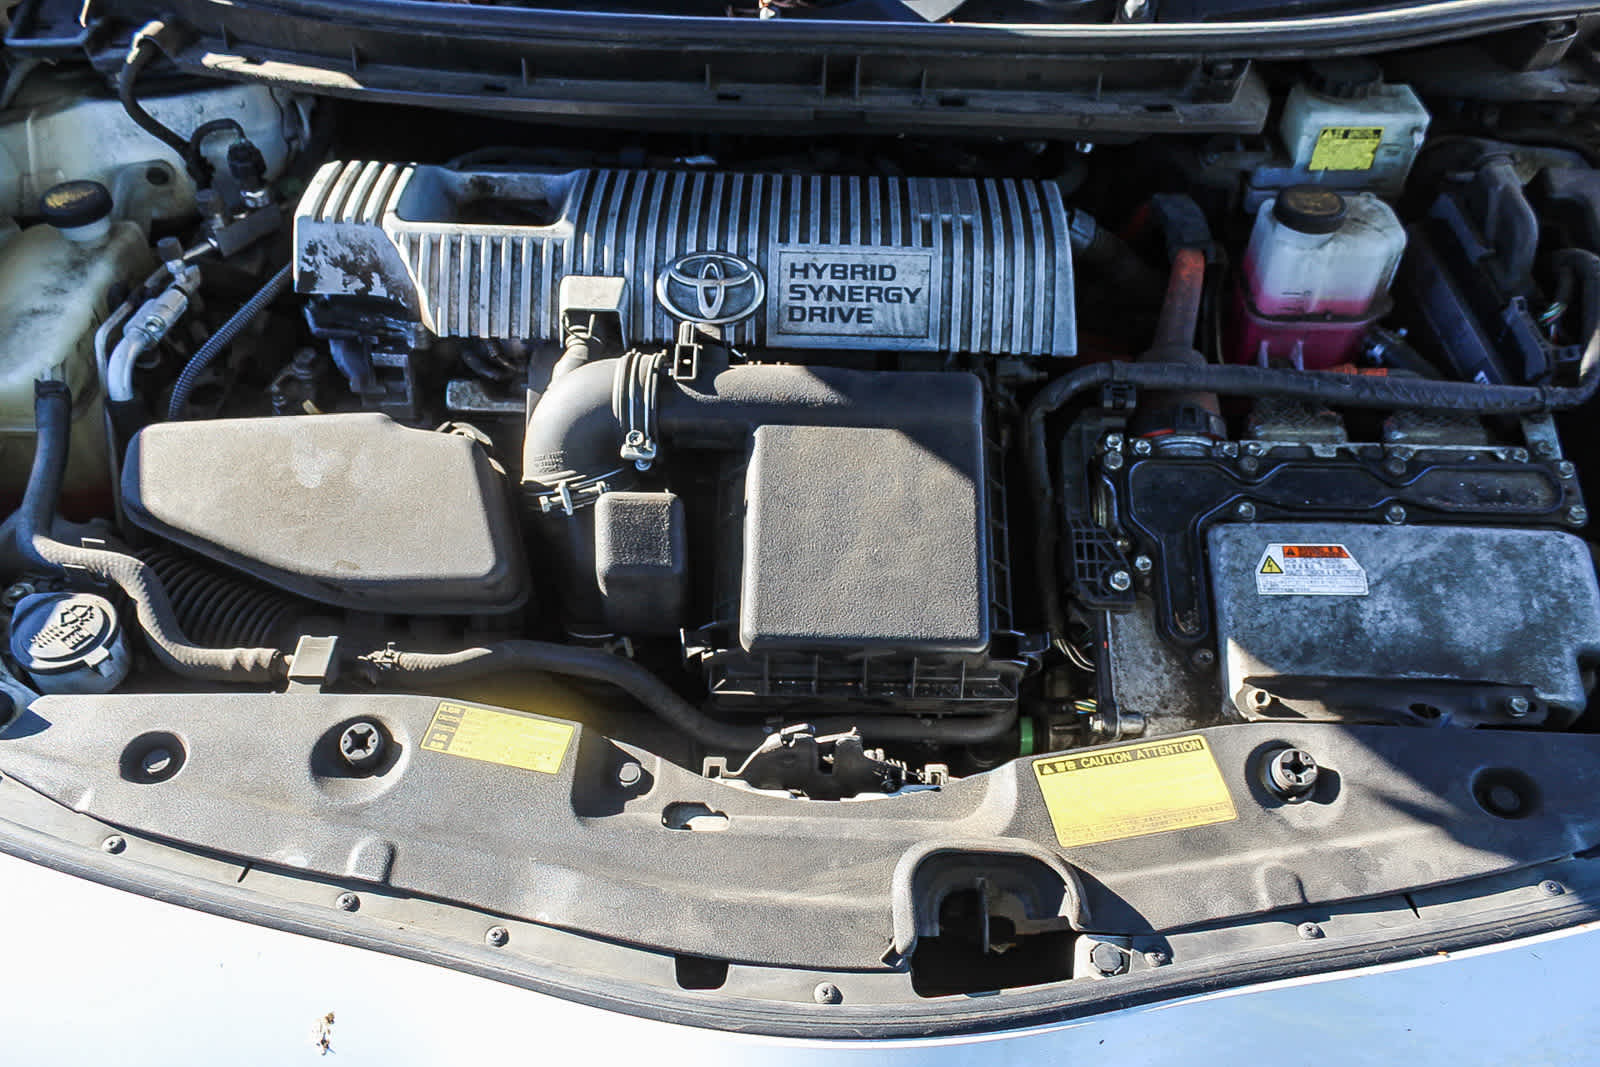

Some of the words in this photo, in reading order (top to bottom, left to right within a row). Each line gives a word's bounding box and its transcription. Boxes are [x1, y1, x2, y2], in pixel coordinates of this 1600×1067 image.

[789, 262, 897, 281] HYBRID
[788, 284, 922, 304] SYNERGY
[787, 306, 874, 324] DRIVE
[1080, 750, 1133, 768] CAUTION
[1136, 740, 1202, 760] ATTENTION
